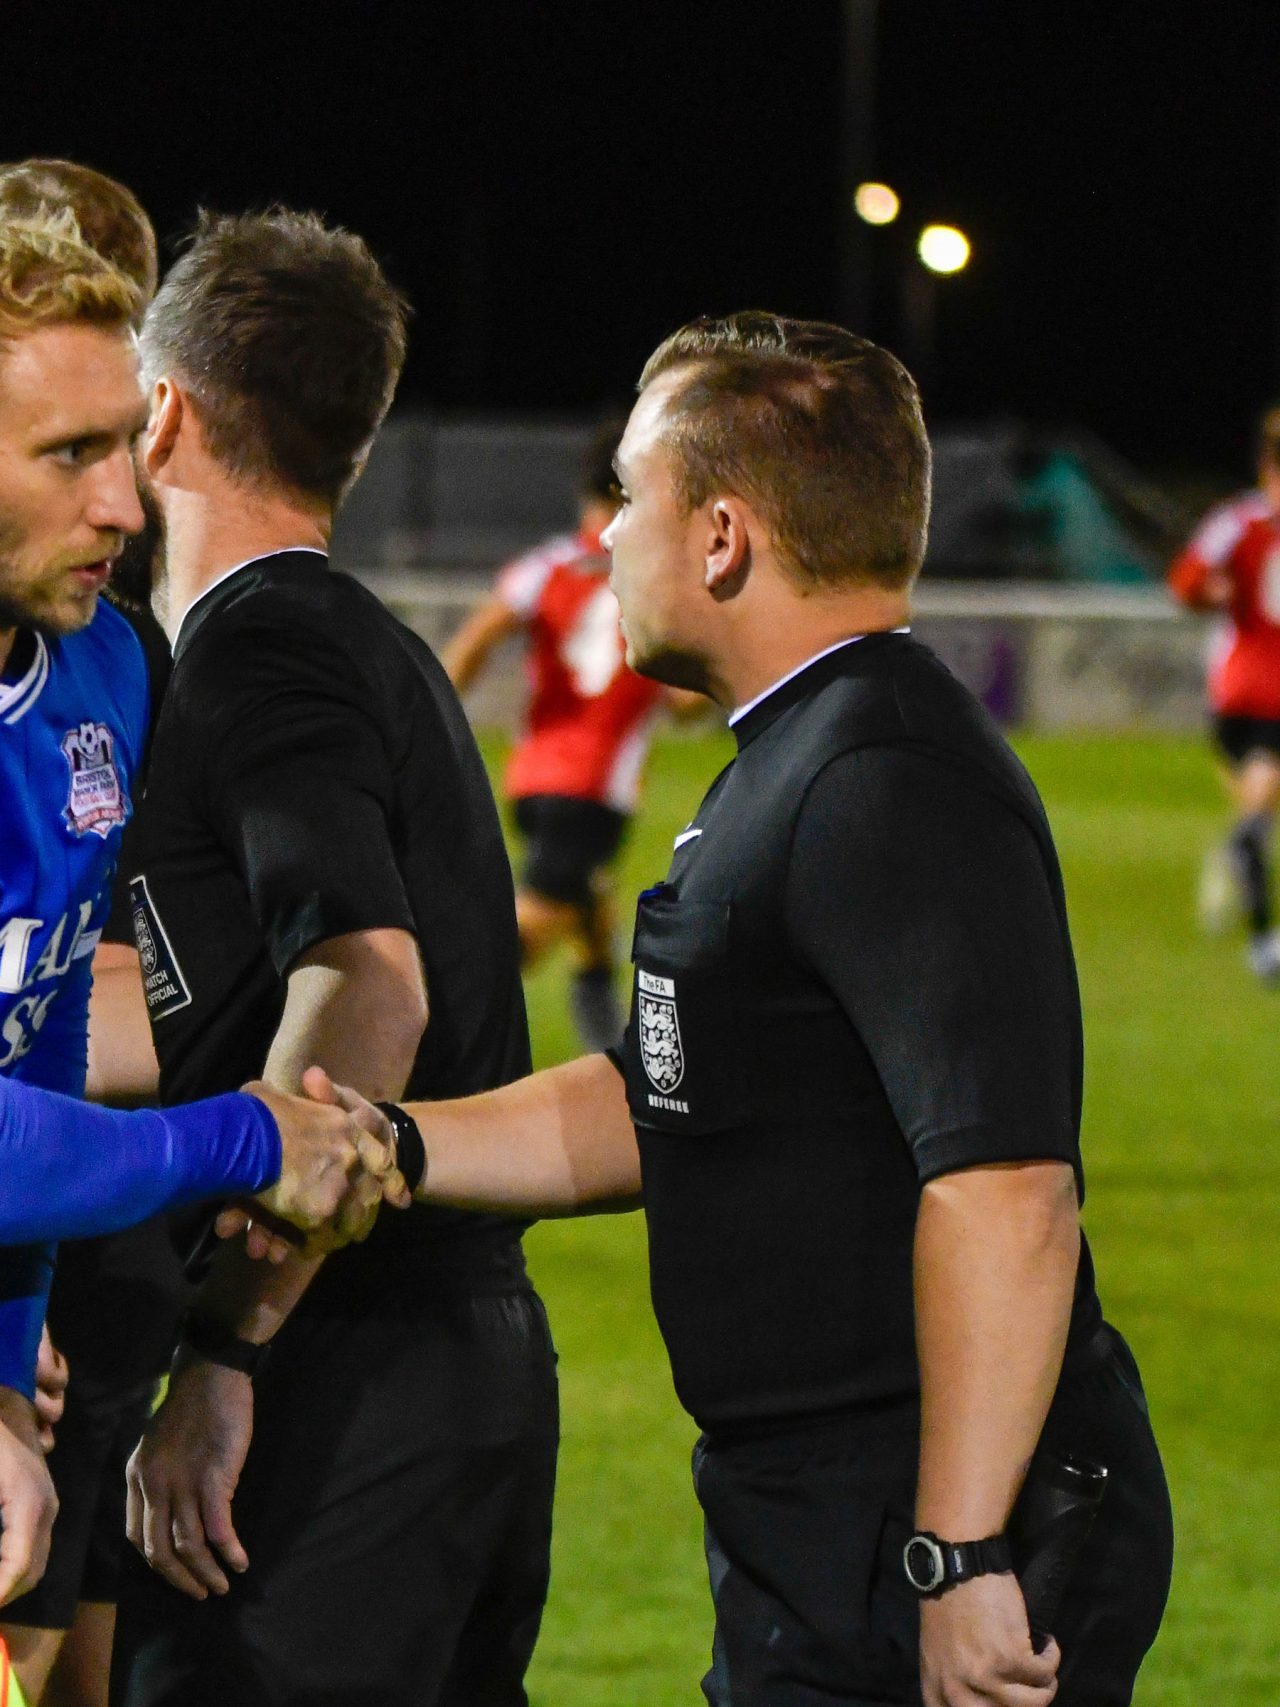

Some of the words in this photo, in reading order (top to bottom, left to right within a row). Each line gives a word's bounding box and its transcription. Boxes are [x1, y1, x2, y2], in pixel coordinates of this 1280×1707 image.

[147, 983, 178, 1007] OFFICIAL
[643, 975, 655, 991] The
[655, 979, 666, 994] FA
[648, 1093, 690, 1114] REFEREE
